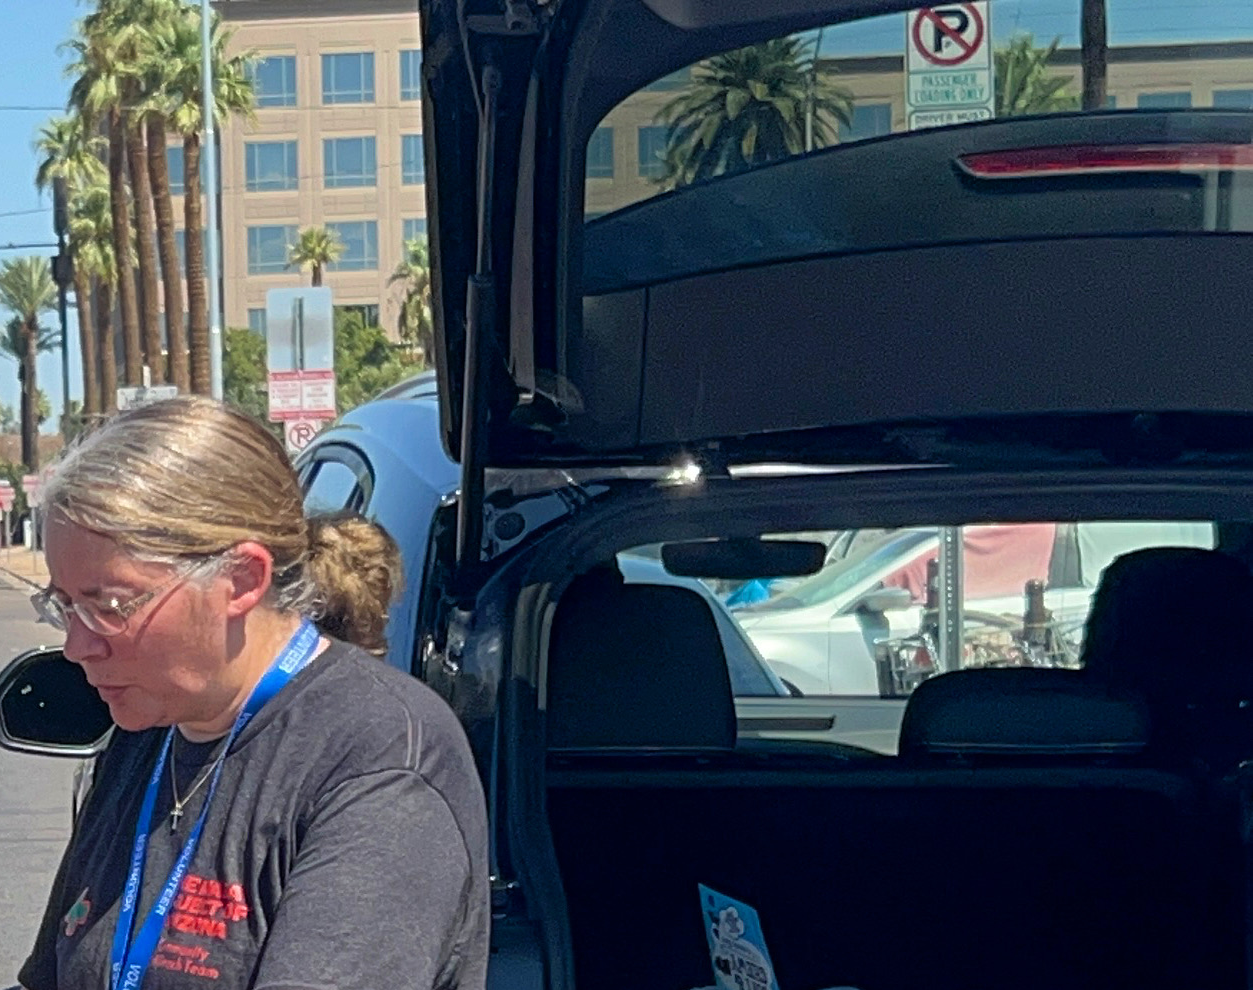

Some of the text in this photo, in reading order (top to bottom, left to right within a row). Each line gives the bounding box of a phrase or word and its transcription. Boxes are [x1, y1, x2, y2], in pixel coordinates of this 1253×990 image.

[921, 73, 978, 88] PASSENGER
[914, 87, 985, 103] LOADING ONLY
[154, 838, 195, 917] VOLUNTEER
